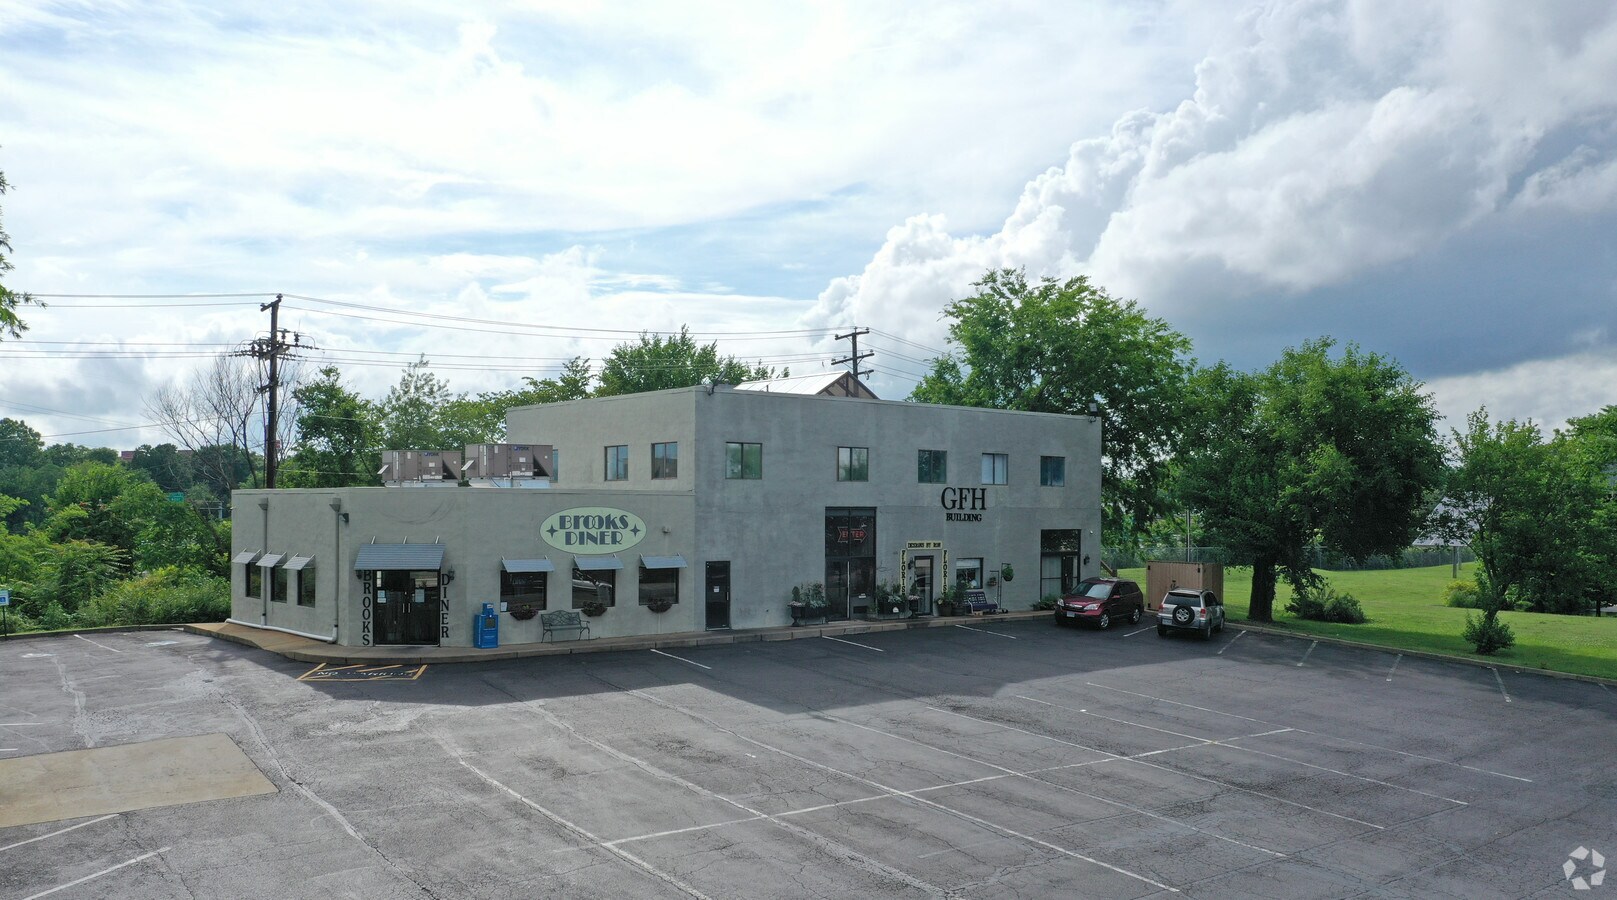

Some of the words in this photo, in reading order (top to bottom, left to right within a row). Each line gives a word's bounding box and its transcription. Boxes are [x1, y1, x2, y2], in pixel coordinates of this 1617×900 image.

[941, 487, 987, 510] GFH
[946, 513, 982, 522] BUILDING
[565, 531, 623, 545] DINER
[842, 530, 865, 538] ETER
[362, 570, 372, 646] BROOKS
[441, 574, 450, 638] DINER
